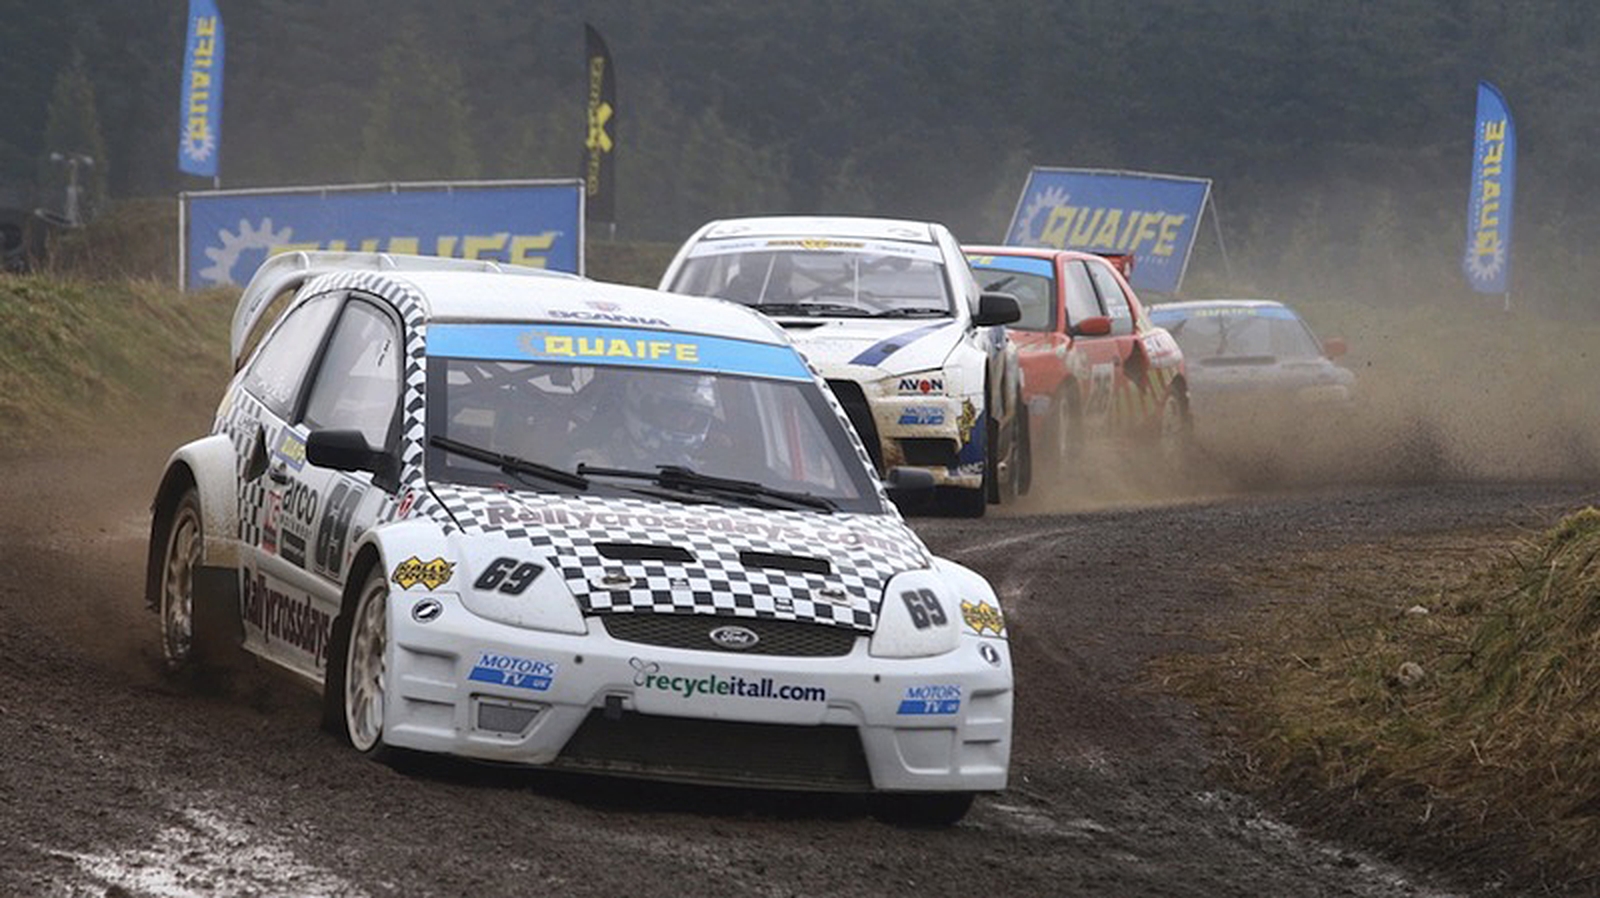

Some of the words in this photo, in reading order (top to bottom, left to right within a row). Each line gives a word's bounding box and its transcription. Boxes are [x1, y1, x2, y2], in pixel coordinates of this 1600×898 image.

[1040, 206, 1186, 257] QUAIFE
[547, 310, 672, 328] SCANIA
[544, 335, 700, 362] QUAIFE
[898, 379, 944, 393] AVON
[283, 476, 318, 526] arco
[486, 504, 902, 555] Rallycrossdays.com
[473, 557, 545, 596] 69
[901, 588, 948, 630] 69
[718, 630, 748, 643] Ford
[479, 654, 555, 675] MOTORS
[501, 673, 526, 686] TV
[645, 673, 827, 702] recycleitall.com
[905, 684, 962, 699] MOTORS
[924, 700, 943, 713] TV
